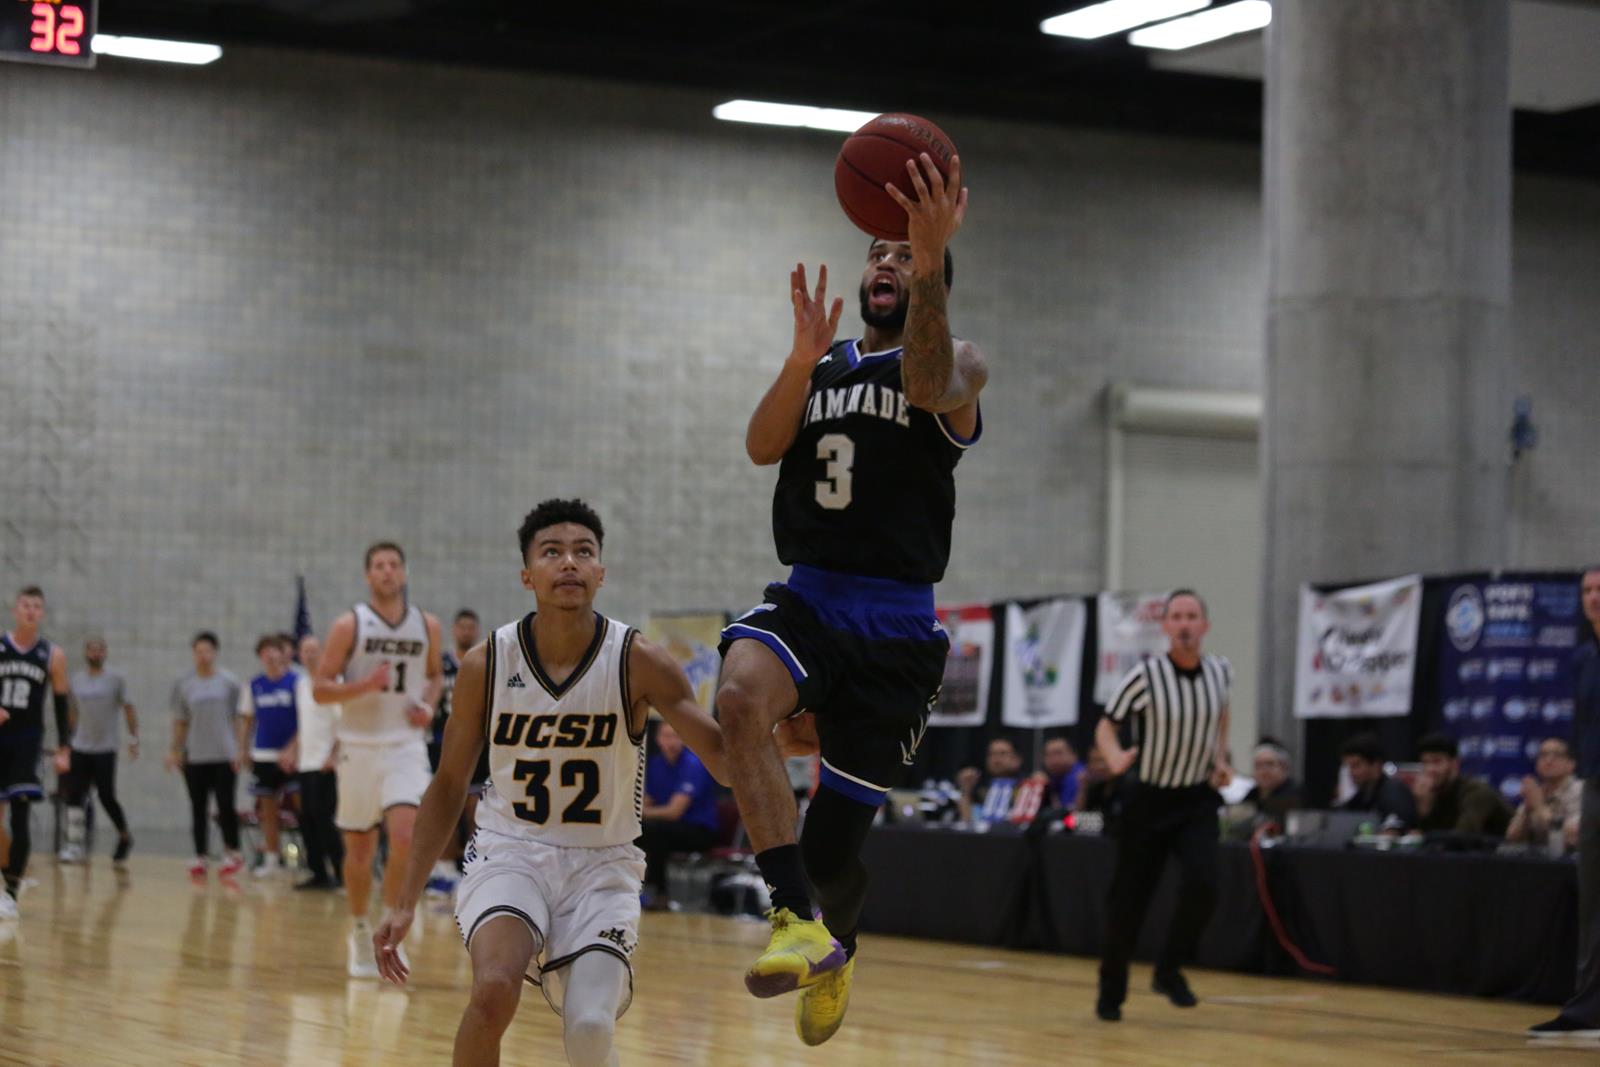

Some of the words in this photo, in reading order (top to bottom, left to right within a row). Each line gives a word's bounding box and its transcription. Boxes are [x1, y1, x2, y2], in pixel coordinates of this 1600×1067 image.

[30, 2, 84, 55] 32
[815, 433, 855, 511] 3
[365, 638, 423, 656] UCSD
[493, 712, 618, 748] UCSD
[512, 758, 602, 826] 32
